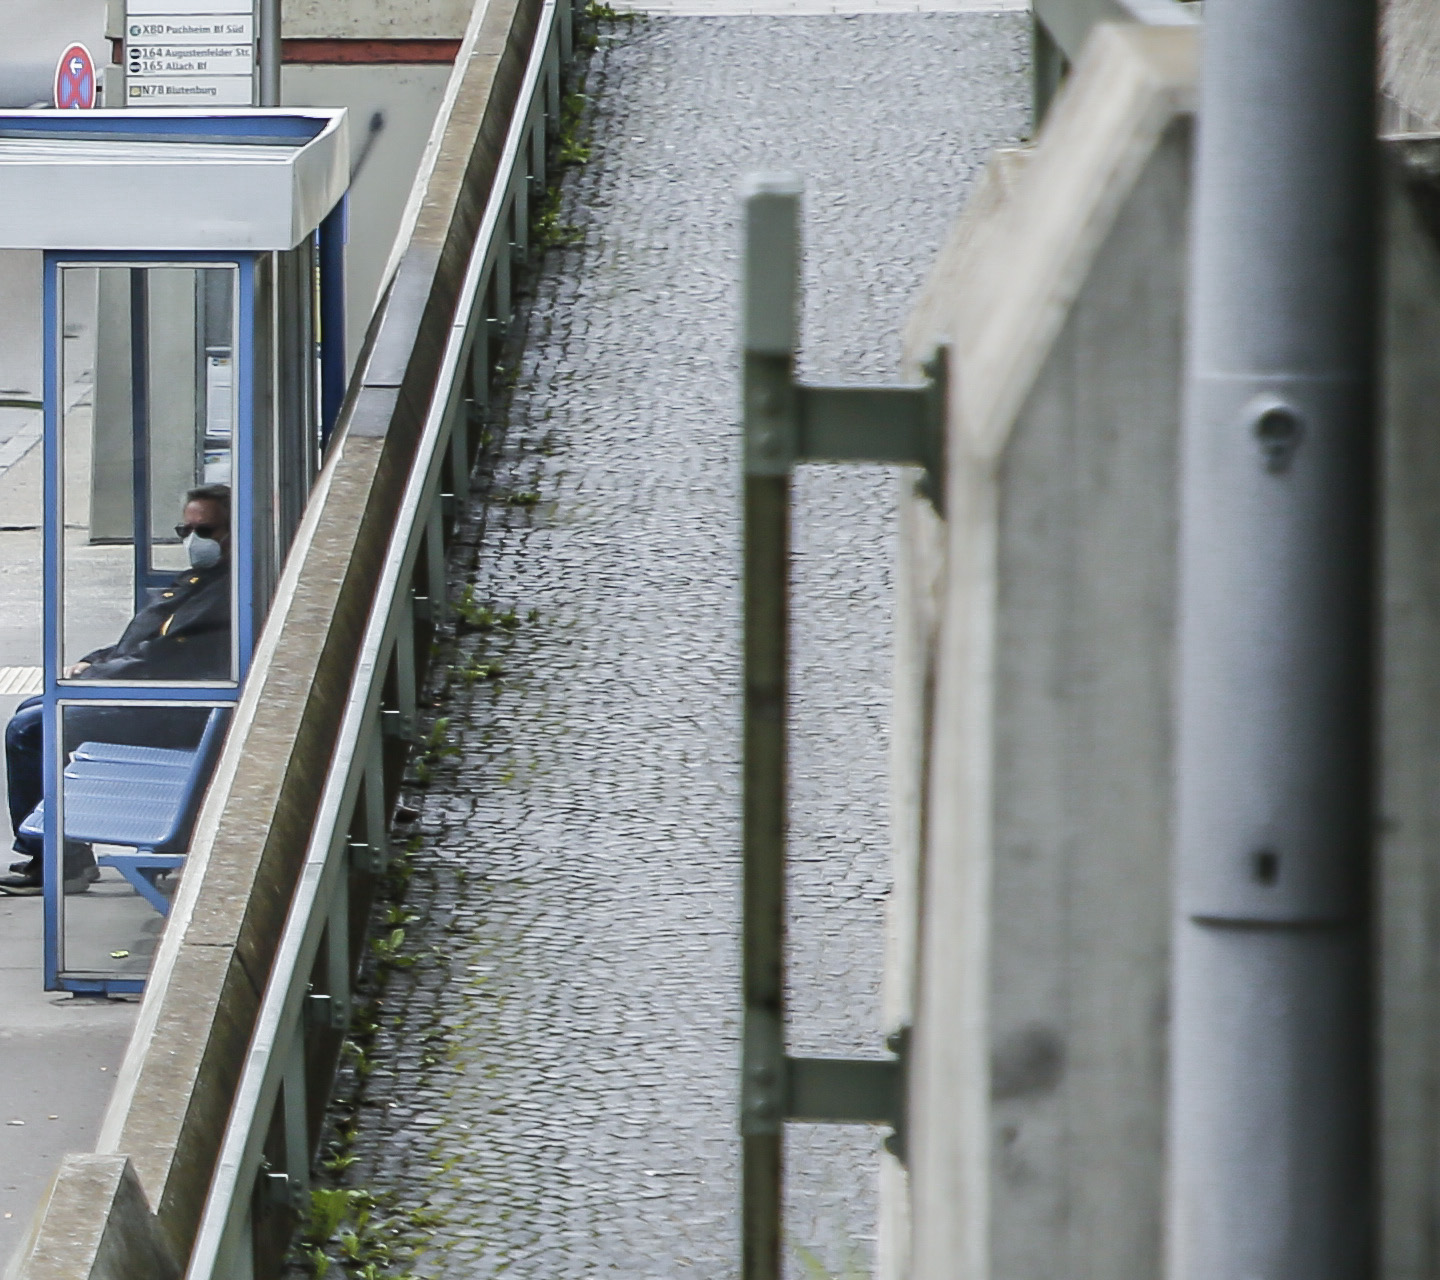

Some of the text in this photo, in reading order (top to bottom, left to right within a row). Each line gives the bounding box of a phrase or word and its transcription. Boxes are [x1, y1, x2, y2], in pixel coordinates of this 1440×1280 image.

[142, 24, 245, 35] X80 Puchheim Bf Süd
[142, 48, 163, 57] 164
[165, 48, 233, 59] Augustenfelder
[142, 60, 208, 71] 165 Allach Bf
[142, 85, 218, 96] N78 Blutenburg
